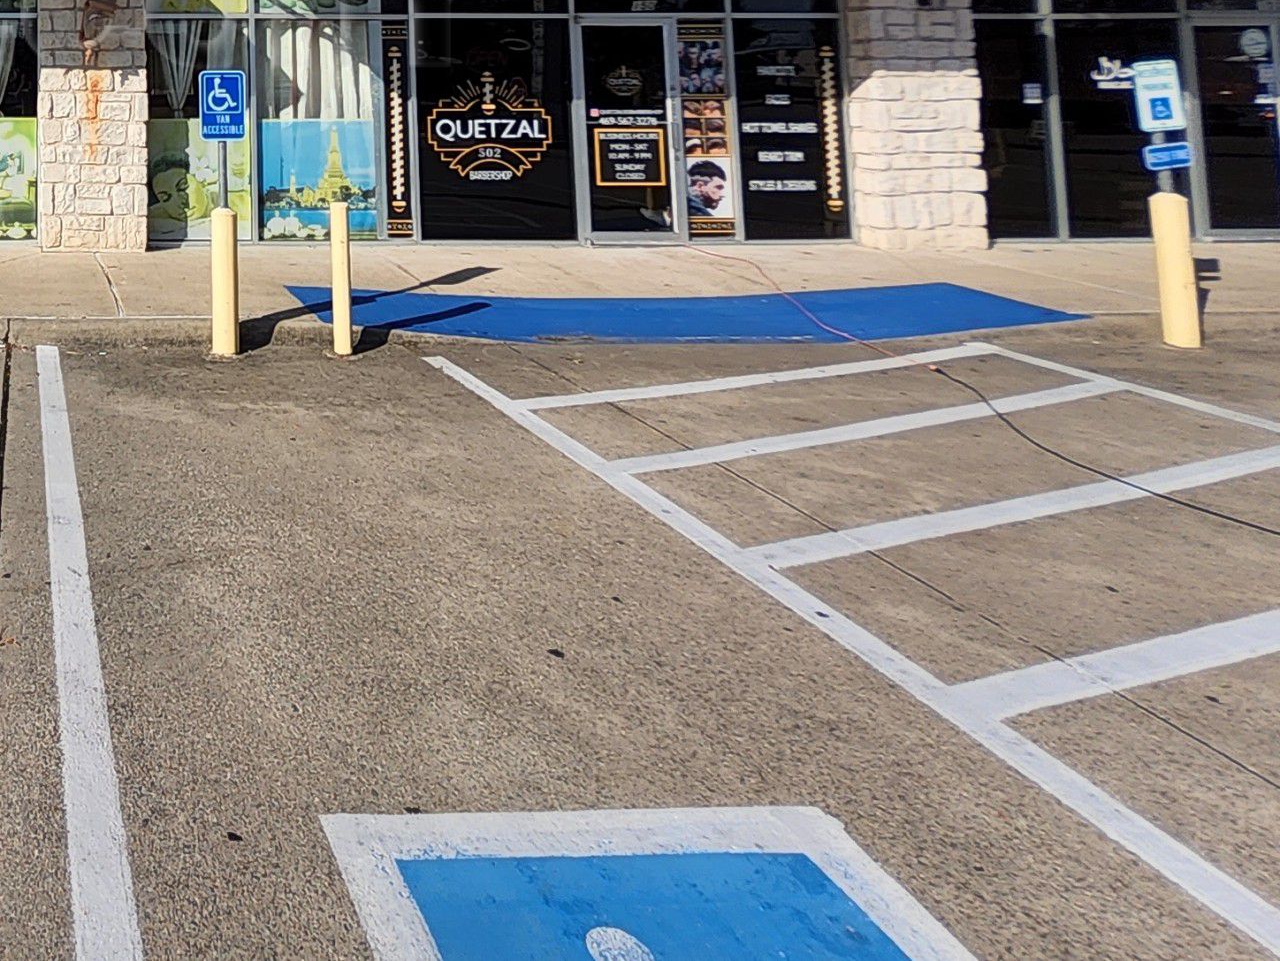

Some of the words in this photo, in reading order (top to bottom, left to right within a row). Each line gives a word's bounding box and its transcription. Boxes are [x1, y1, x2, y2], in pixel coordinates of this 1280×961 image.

[216, 115, 230, 123] VAN
[203, 126, 243, 134] ACCESSIBLE
[436, 119, 546, 141] QUETZAL
[478, 148, 501, 157] 502
[469, 171, 512, 180] BARBERSHOP
